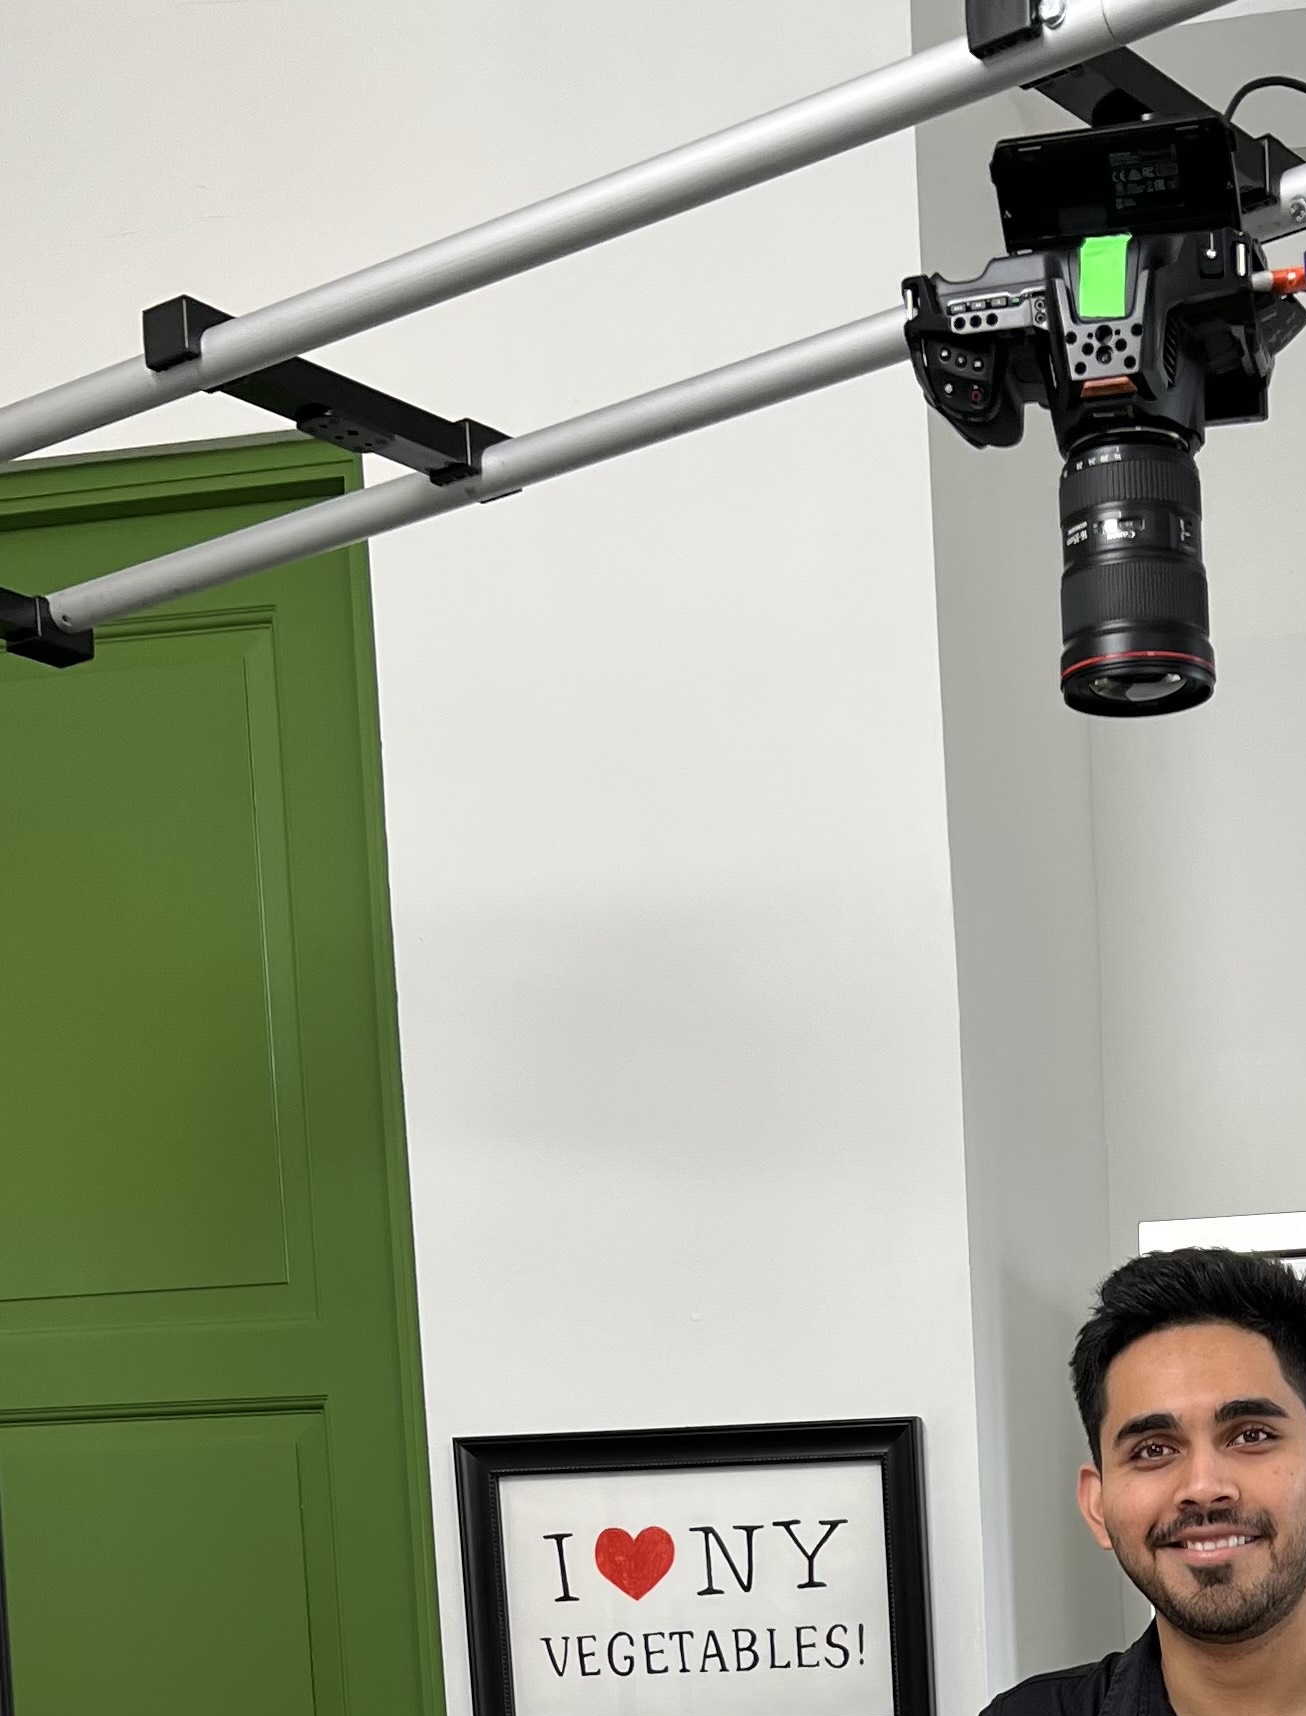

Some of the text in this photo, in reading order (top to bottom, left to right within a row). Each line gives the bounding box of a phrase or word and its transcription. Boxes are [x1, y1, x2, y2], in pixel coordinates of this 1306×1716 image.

[543, 1518, 849, 1603] I NY
[539, 1622, 865, 1678] VEGETABLES!
